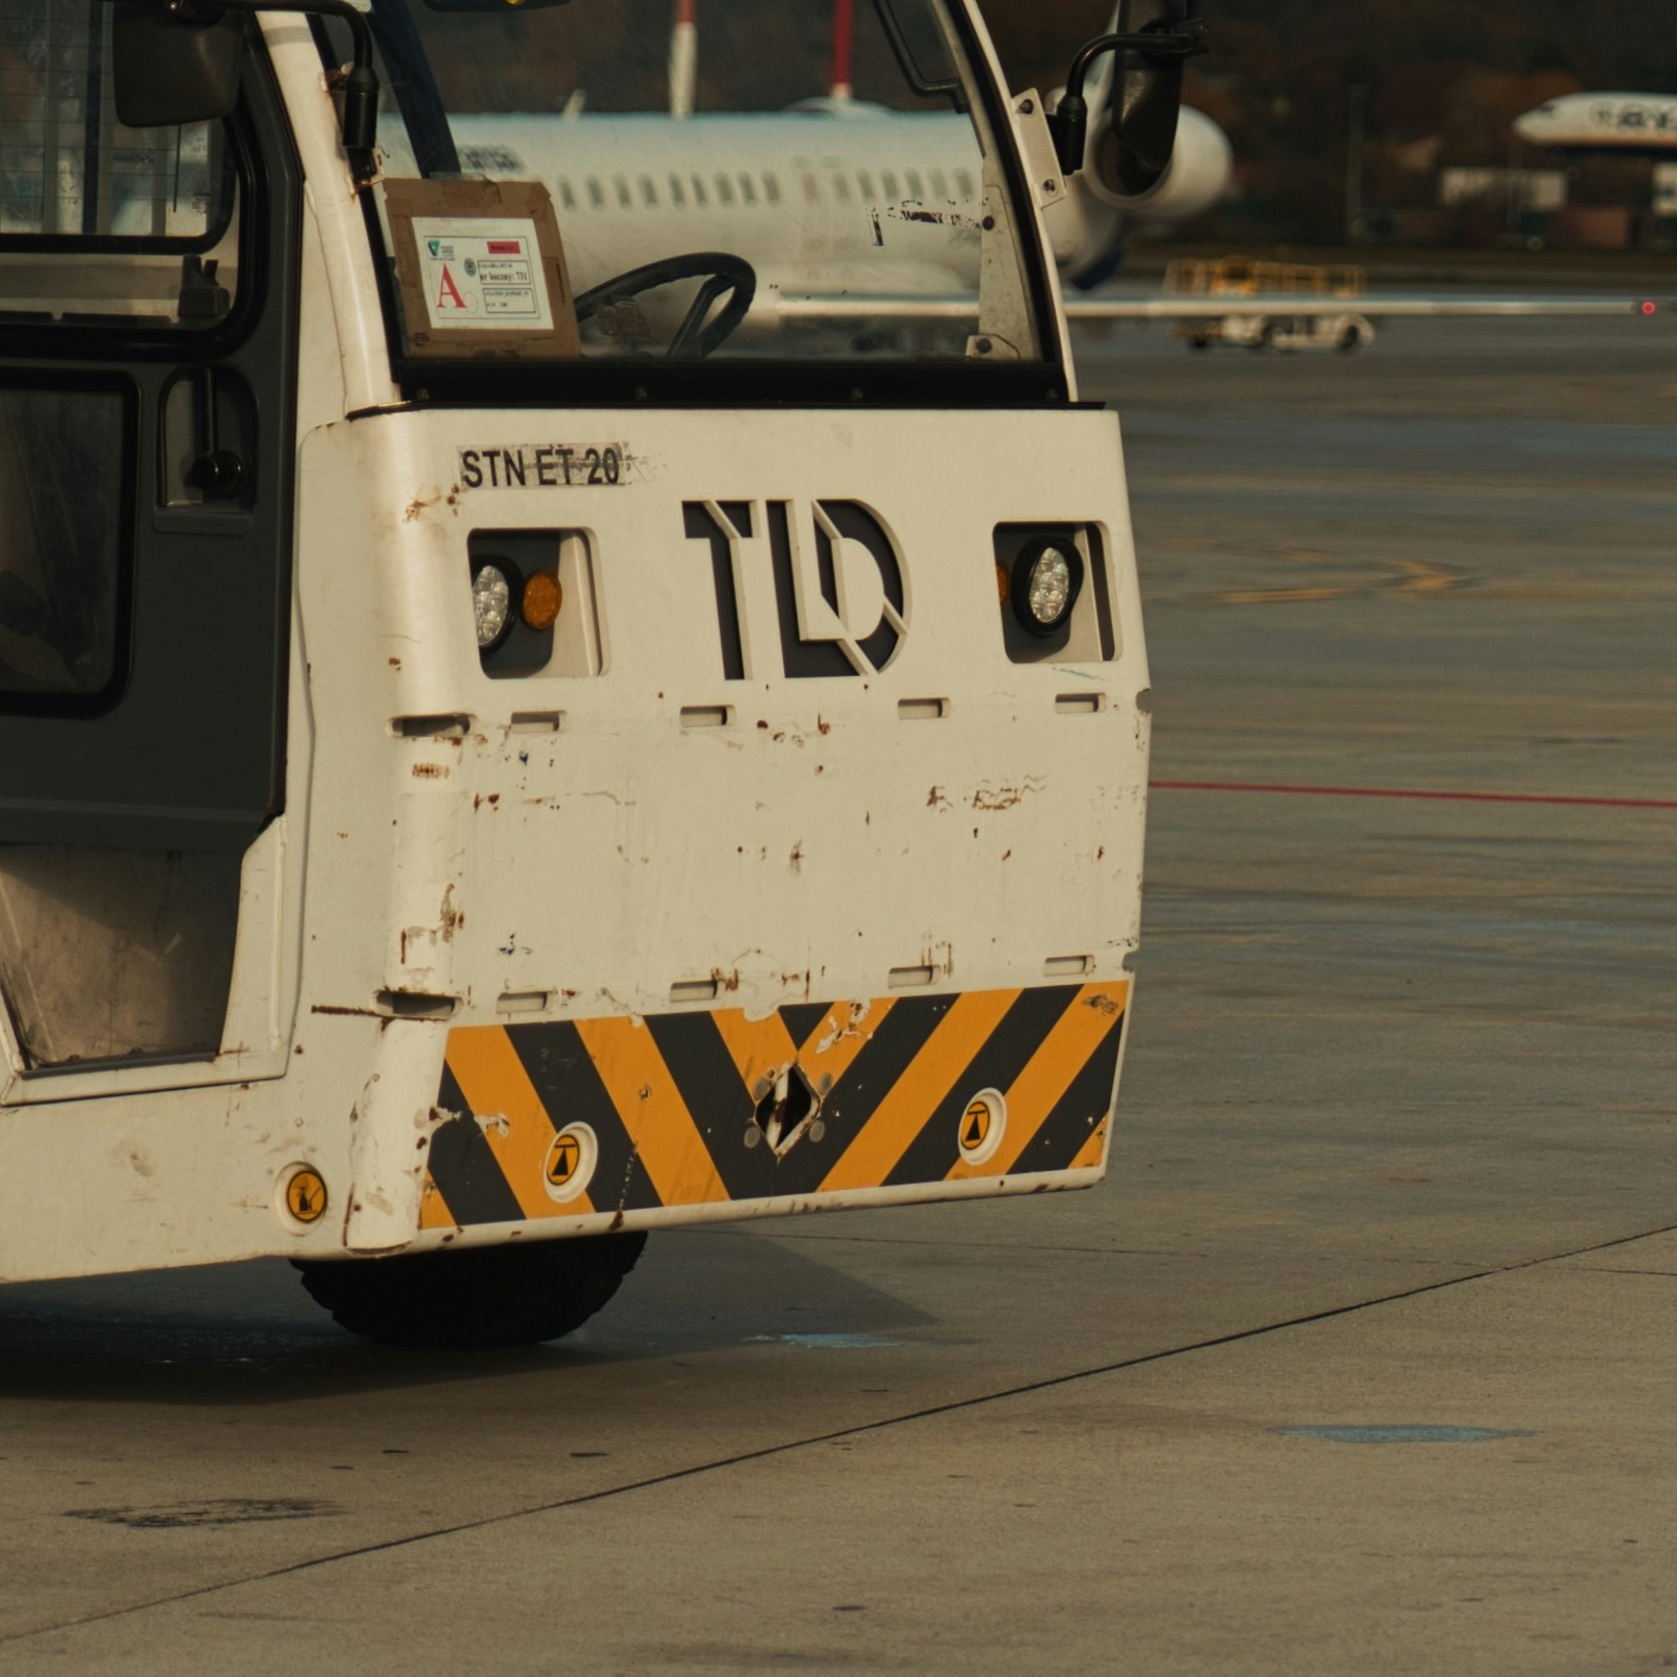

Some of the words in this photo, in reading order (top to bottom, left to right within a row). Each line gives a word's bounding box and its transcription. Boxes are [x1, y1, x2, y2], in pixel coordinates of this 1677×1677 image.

[436, 262, 467, 308] A
[516, 271, 528, 281] 731
[462, 449, 526, 489] STN
[535, 449, 574, 486] ET
[584, 447, 620, 485] 20
[682, 498, 912, 680] TLD
